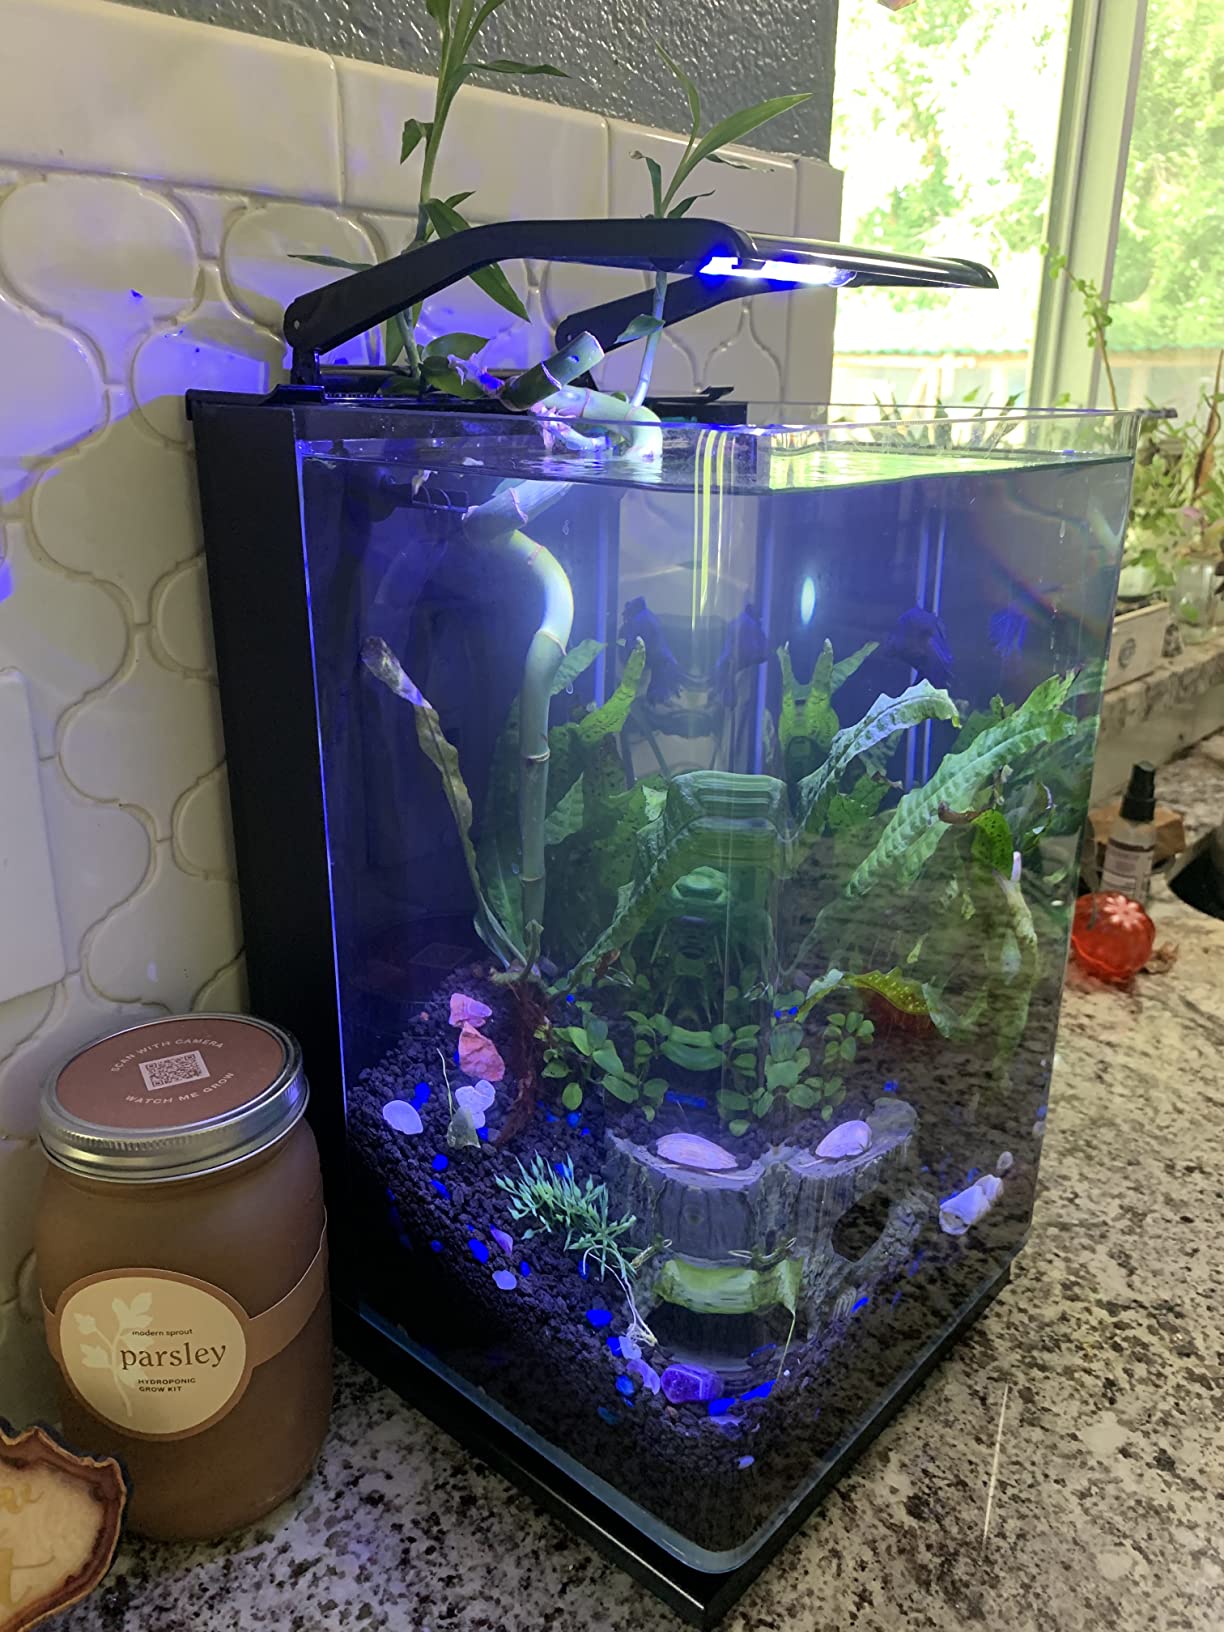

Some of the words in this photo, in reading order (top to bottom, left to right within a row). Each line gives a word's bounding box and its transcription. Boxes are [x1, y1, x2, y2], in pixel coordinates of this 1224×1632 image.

[111, 1053, 135, 1072] SCAN
[137, 1041, 170, 1054] WITH
[175, 1039, 224, 1049] CAMERA
[125, 1095, 173, 1104] WATCH
[178, 1092, 200, 1102] ME
[203, 1072, 235, 1093] GROW
[166, 1329, 193, 1337] sprout
[120, 1342, 226, 1370] parsley
